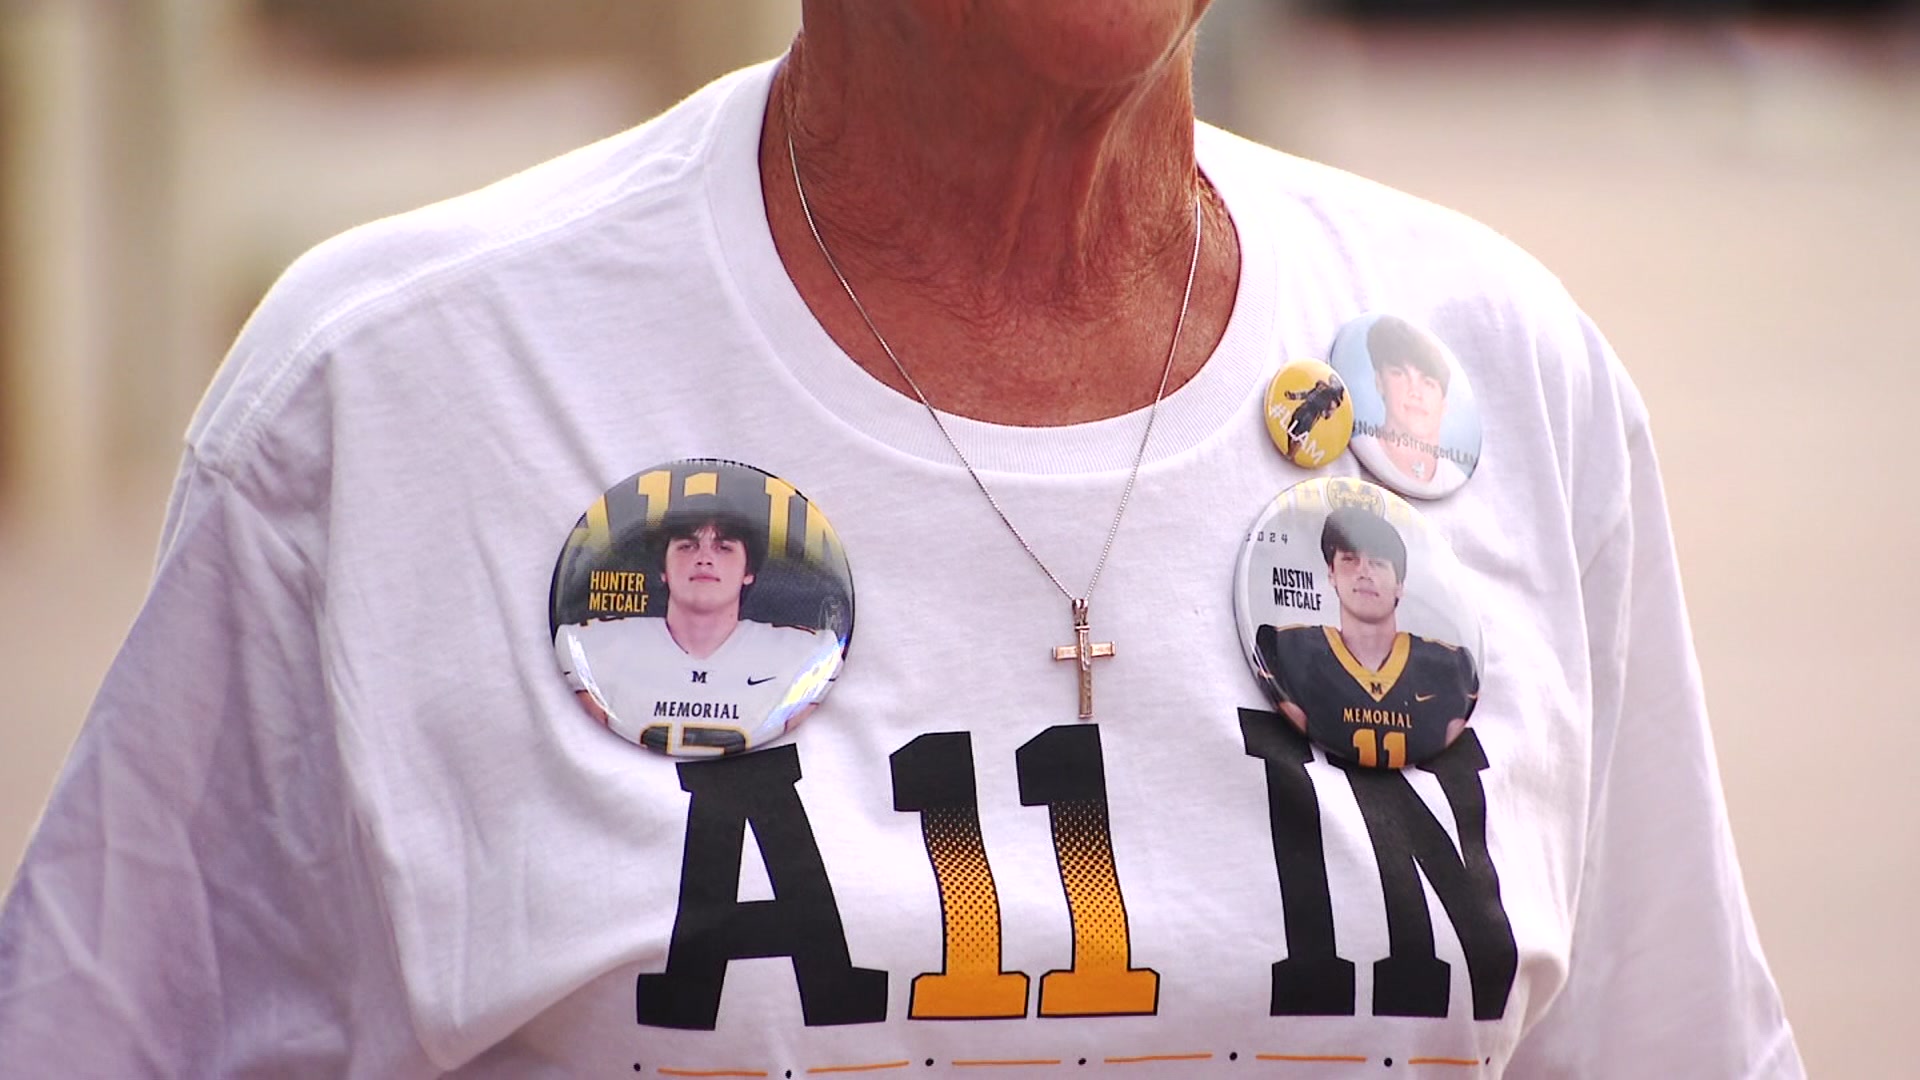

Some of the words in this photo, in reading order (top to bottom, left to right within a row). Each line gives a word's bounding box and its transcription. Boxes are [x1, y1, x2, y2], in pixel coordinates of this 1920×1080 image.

[1271, 403, 1327, 466] #LLAM
[590, 570, 645, 592] HUNTER
[1272, 567, 1314, 590] AUSTIN
[588, 592, 649, 613] METCALF
[1273, 587, 1322, 611] METCALF
[692, 671, 707, 684] M
[1370, 681, 1383, 695] M
[653, 701, 740, 720] MEMORIAL
[1343, 707, 1412, 729] MEMORIAL
[1352, 728, 1407, 769] 11
[636, 723, 1160, 1031] A11
[1236, 706, 1519, 1021] IN
